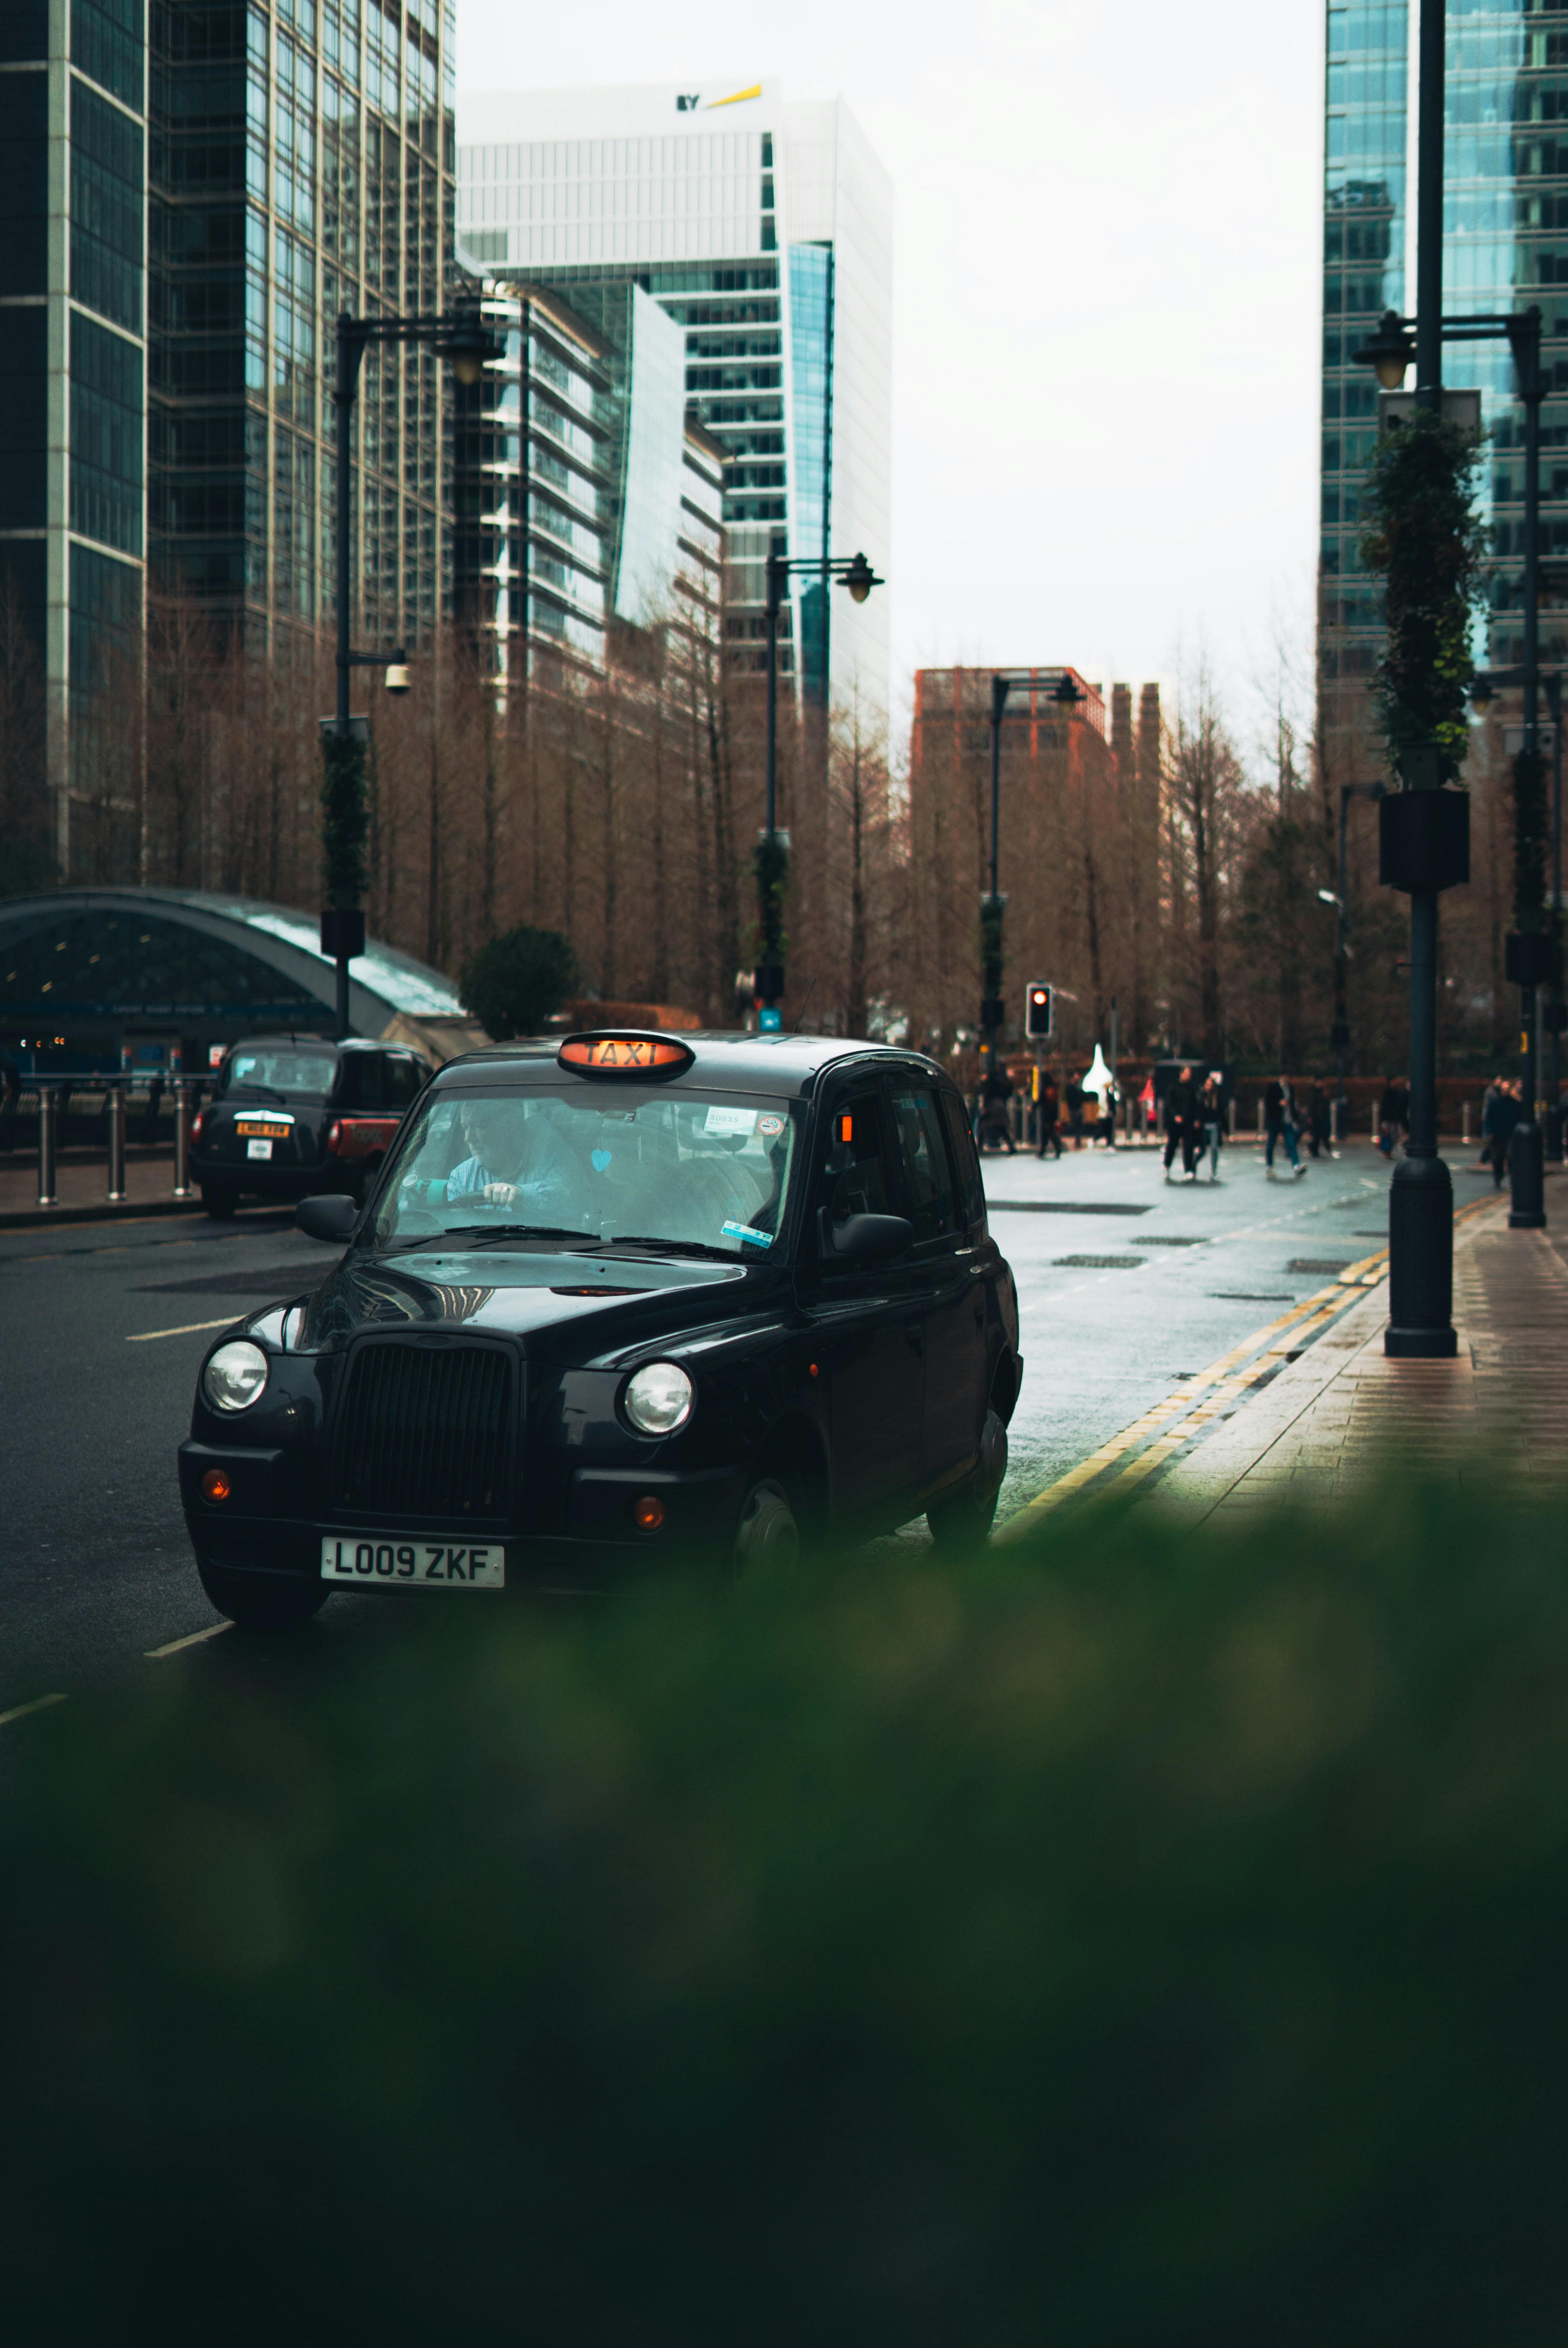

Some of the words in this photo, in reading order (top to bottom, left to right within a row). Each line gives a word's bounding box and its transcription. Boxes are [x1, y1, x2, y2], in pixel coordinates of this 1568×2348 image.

[585, 1043, 657, 1065] TAXI
[335, 1542, 415, 1577] LO09
[426, 1547, 488, 1580] ZKF
